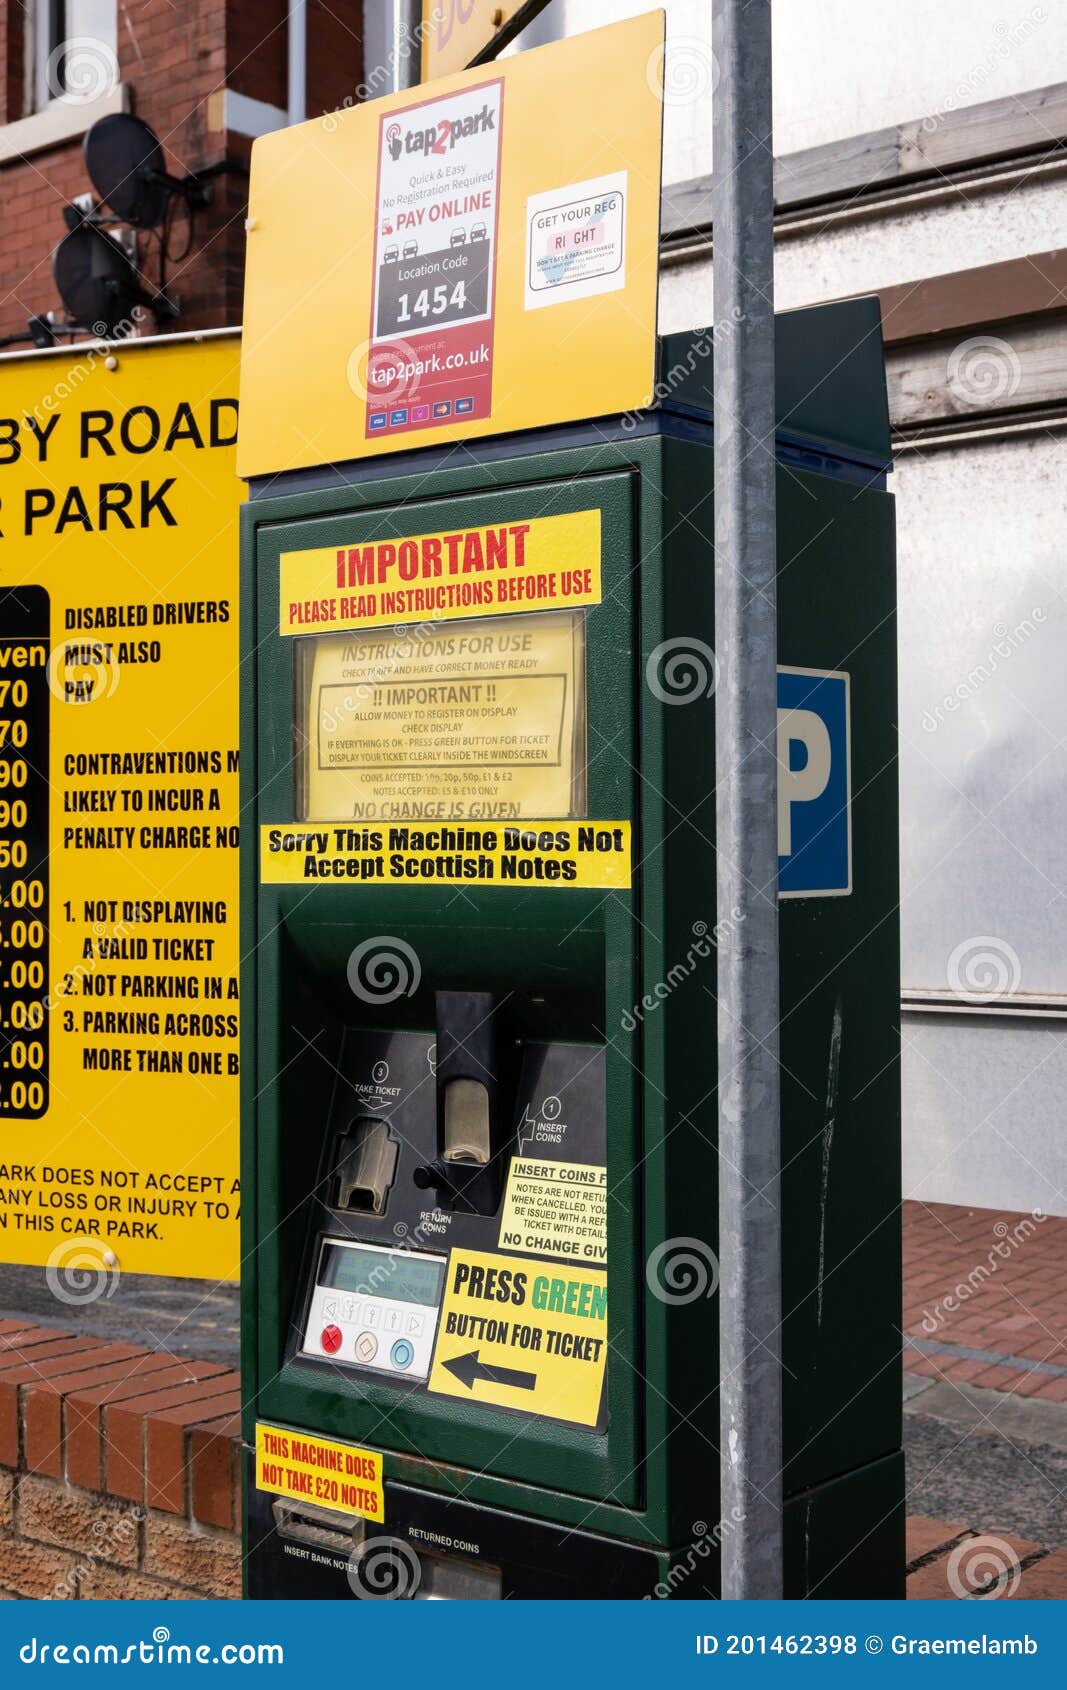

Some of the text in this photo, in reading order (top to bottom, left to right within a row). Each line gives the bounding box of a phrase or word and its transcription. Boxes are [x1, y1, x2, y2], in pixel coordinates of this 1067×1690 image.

[405, 105, 495, 155] tap2park
[409, 164, 466, 188] Quick Easy
[383, 170, 494, 209] No Registration Required
[397, 191, 492, 232] PAY ONLINE
[537, 199, 616, 229] GET YOUR REG
[574, 228, 596, 244] GHT
[398, 254, 468, 282] Location Code
[396, 281, 467, 323] 1454
[372, 344, 490, 385] tap2park.co.uk
[80, 398, 239, 458] ROAD
[24, 478, 179, 536] PARK
[336, 524, 530, 589] IMPORTANT
[289, 568, 592, 625] PLEASE READ INSTRUCTIONS BEFORE USE
[65, 600, 229, 630] DISABLED DRIVERS
[65, 641, 161, 666] MUST ALSO
[342, 634, 533, 662] INSTRUCTIONS FOR USE
[342, 659, 538, 678] CHECK AND HAVE CORRECT MONEY READY
[387, 685, 483, 706] IMPORTANT
[354, 707, 518, 721] ALLOW MONEY TO REGISTER ON DISPLAY
[402, 722, 463, 734] CHECK DISPLAY
[335, 735, 551, 749] EVERYTHING PRESS GREEN BUTTON FOR TICKET
[64, 751, 222, 776] CONTRAVENTIONS
[329, 749, 548, 763] DISPLAY YOUR TICKET CLEARLY INSIDE THE WINDSCREEN
[777, 707, 831, 856] P
[64, 788, 220, 812] LIKELY TO INCUR A
[353, 801, 521, 819] NO CHANGE IS GIVEN
[64, 826, 211, 849] PENALTY CHARGE
[268, 827, 624, 855] Sorry This Machine Does Not
[303, 854, 577, 881] Accept Scottish Notes
[63, 901, 227, 924] 1. NOT DISPLAYING
[99, 937, 215, 961] VALID TICKET
[63, 974, 222, 999] 2. NOT PARKING IN
[63, 1010, 238, 1038] 3. PARKING ACROSS
[83, 1048, 222, 1075] MORE THAN ONE
[355, 1084, 401, 1097] TAKE TICKET
[536, 1132, 561, 1143] COINS
[537, 1122, 567, 1134] INSERT
[43, 1167, 225, 1194] DOES NOT ACCEPT
[514, 1163, 596, 1182] INSERT COINS
[511, 1194, 535, 1205] WHEN
[590, 1204, 607, 1214] YOU
[516, 1184, 580, 1199] NOTES ARE NOT
[39, 1191, 229, 1220] LOSS OR INJURY TO
[420, 1211, 452, 1224] RETURN
[514, 1207, 579, 1222] BE ISSUED WITH
[14, 1213, 164, 1240] THIS CAR PARK.
[422, 1221, 447, 1234] COINS
[523, 1219, 574, 1234] TICKET WITH
[503, 1232, 580, 1255] NO CHANGE
[453, 1262, 528, 1306] PRESS
[532, 1275, 608, 1320] GREEN
[446, 1311, 603, 1363] BUTTON FOR TICKET
[264, 1433, 376, 1482] THIS MACHINE DOES
[262, 1463, 378, 1514] NOT TAKE £20 NOTES
[408, 1527, 480, 1554] RETURNED COINS
[284, 1545, 359, 1575] INSERT BANK NOTES
